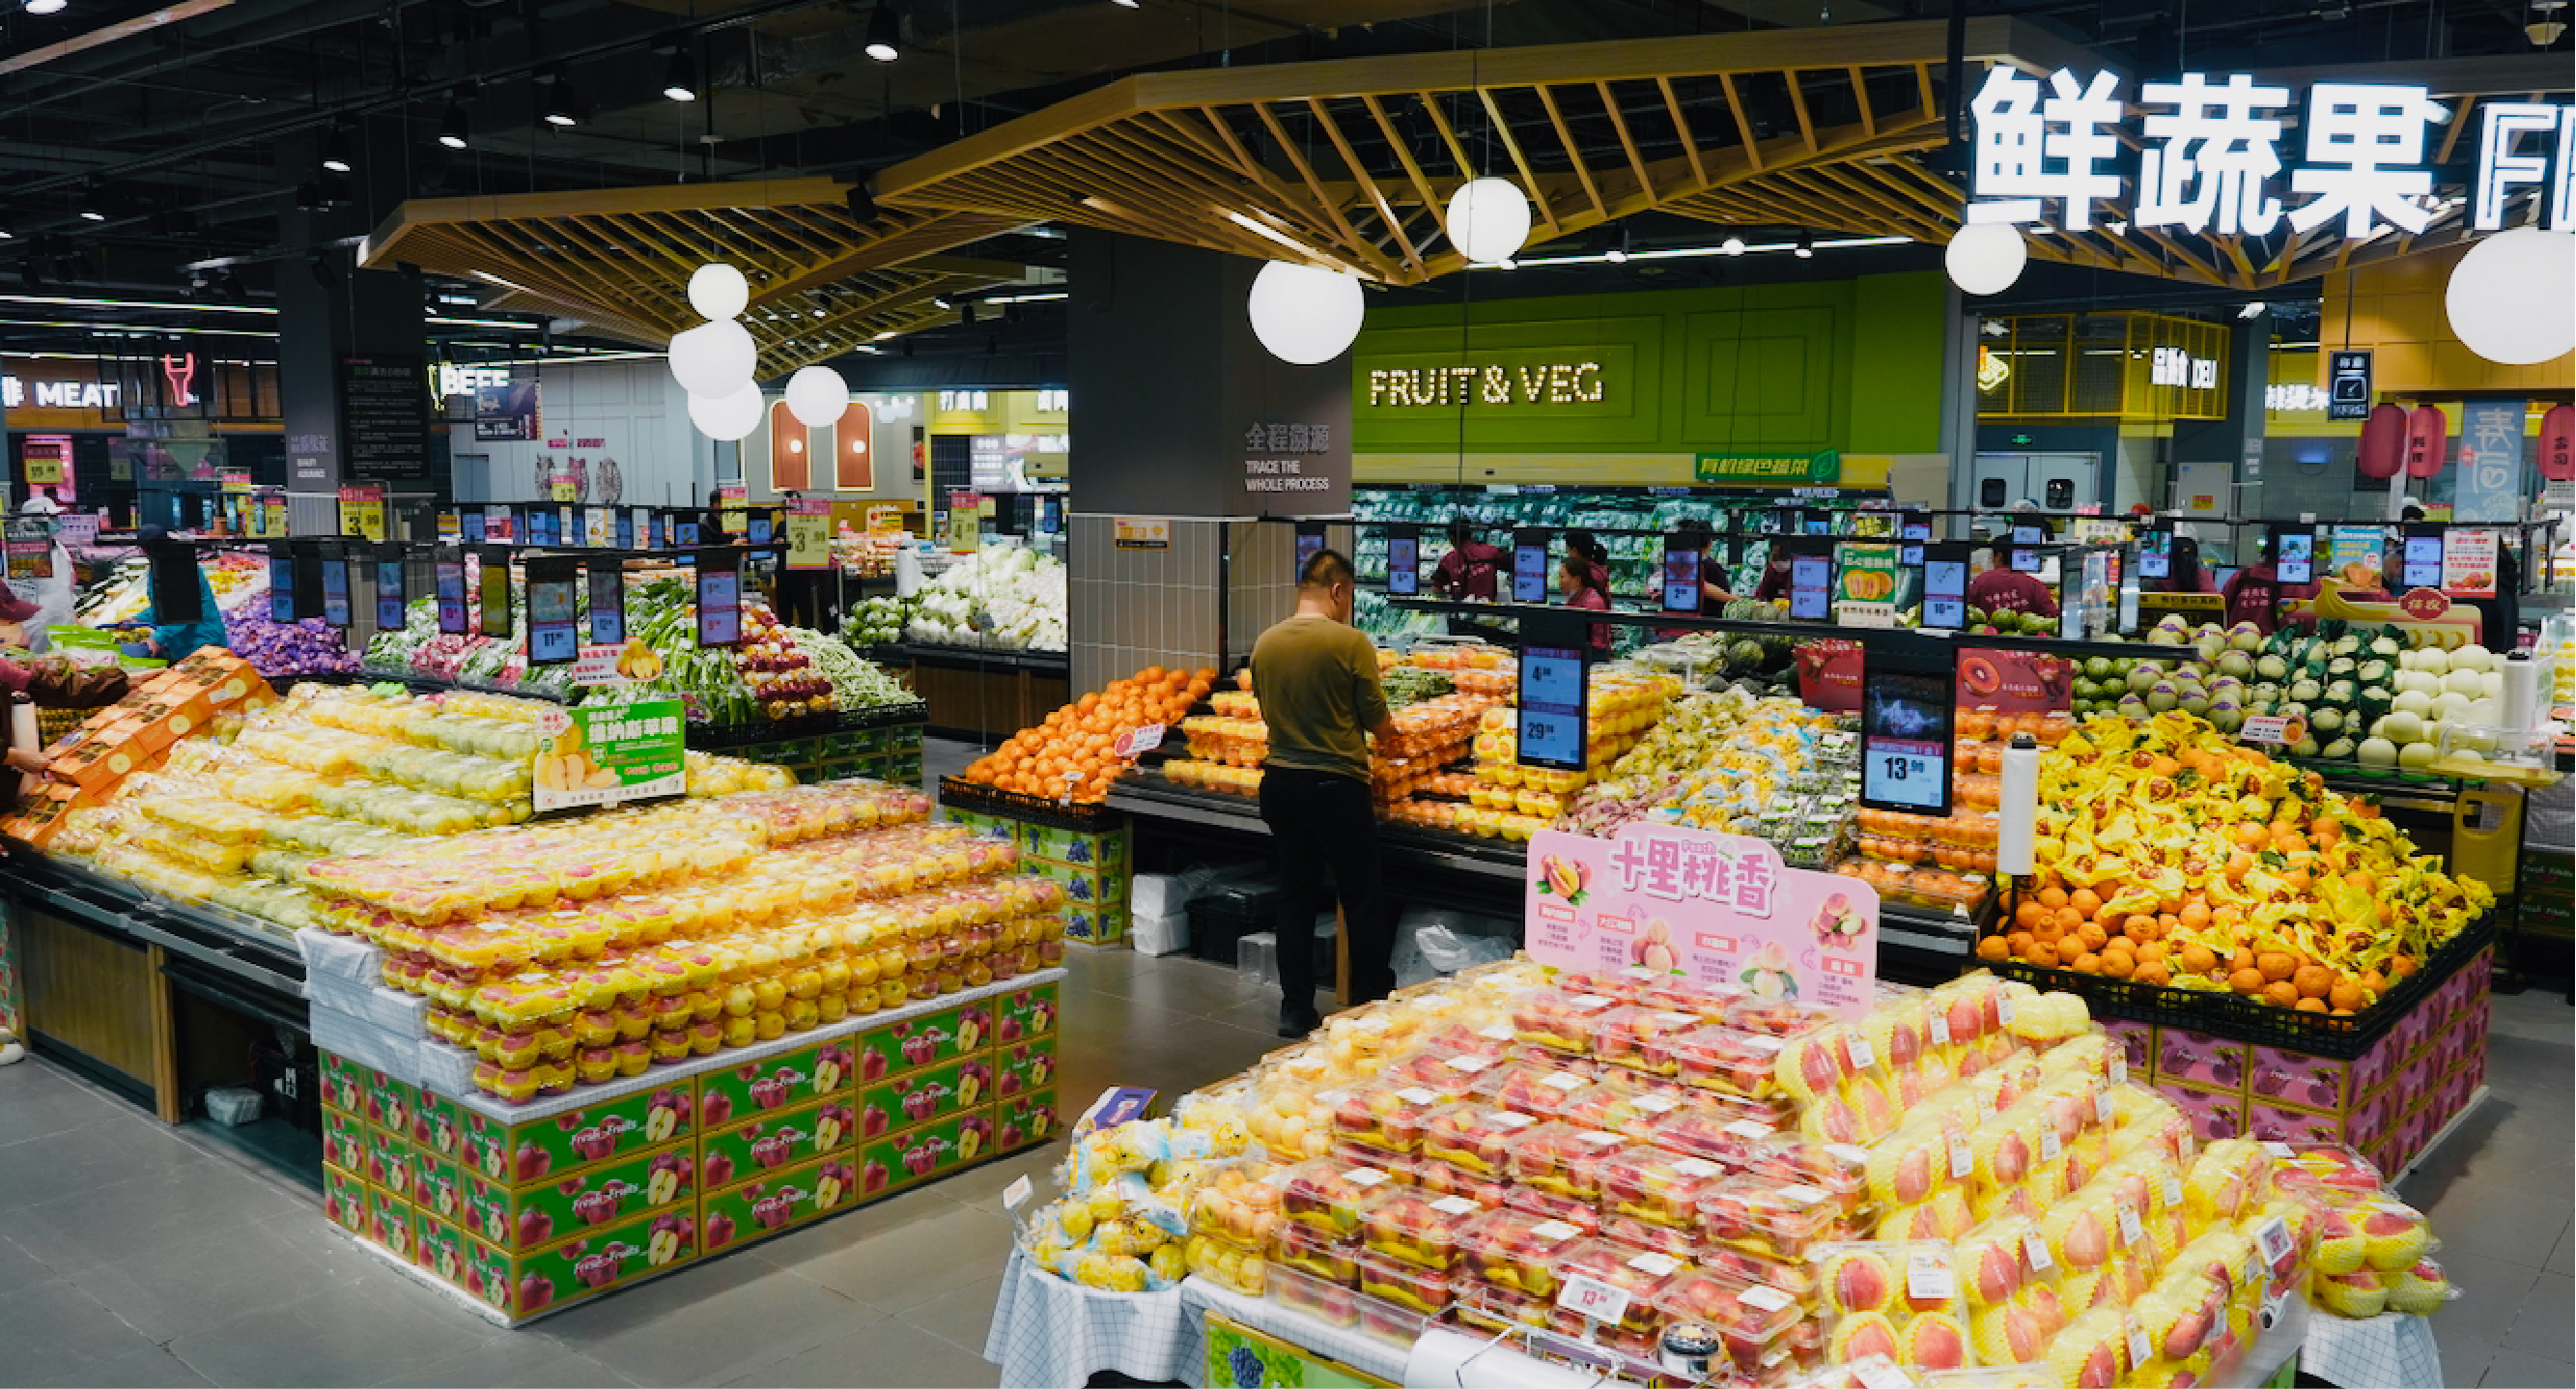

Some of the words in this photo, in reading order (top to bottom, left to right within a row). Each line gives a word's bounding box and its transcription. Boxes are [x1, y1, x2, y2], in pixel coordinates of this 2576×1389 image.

[1966, 65, 2433, 239] 鲜蔬果
[35, 382, 120, 407] MEAT
[1370, 367, 1479, 406] FRUIT
[1481, 364, 1513, 404] &
[1518, 361, 1603, 404] VEG
[1281, 460, 1301, 474] THE
[1611, 837, 1775, 918] 十里桃香
